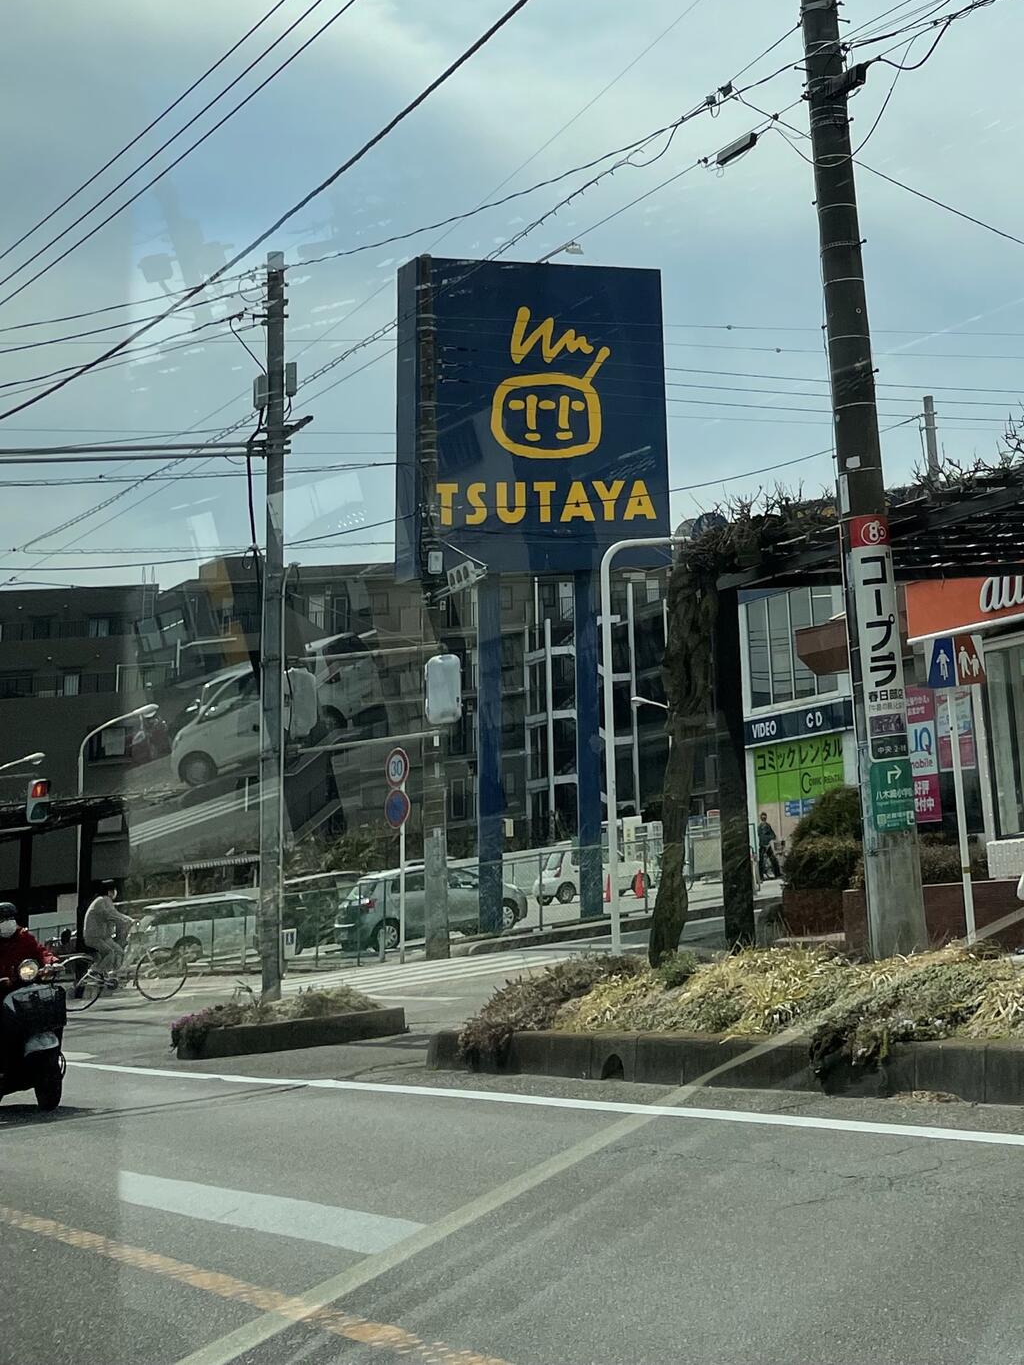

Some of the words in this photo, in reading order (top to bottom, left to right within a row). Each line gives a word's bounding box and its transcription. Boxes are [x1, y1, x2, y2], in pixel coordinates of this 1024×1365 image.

[436, 480, 657, 526] TSUTAYA
[751, 720, 777, 738] VIDEO
[806, 711, 823, 728] CD
[391, 760, 402, 776] 30
[757, 737, 843, 770] コミックレンタル
